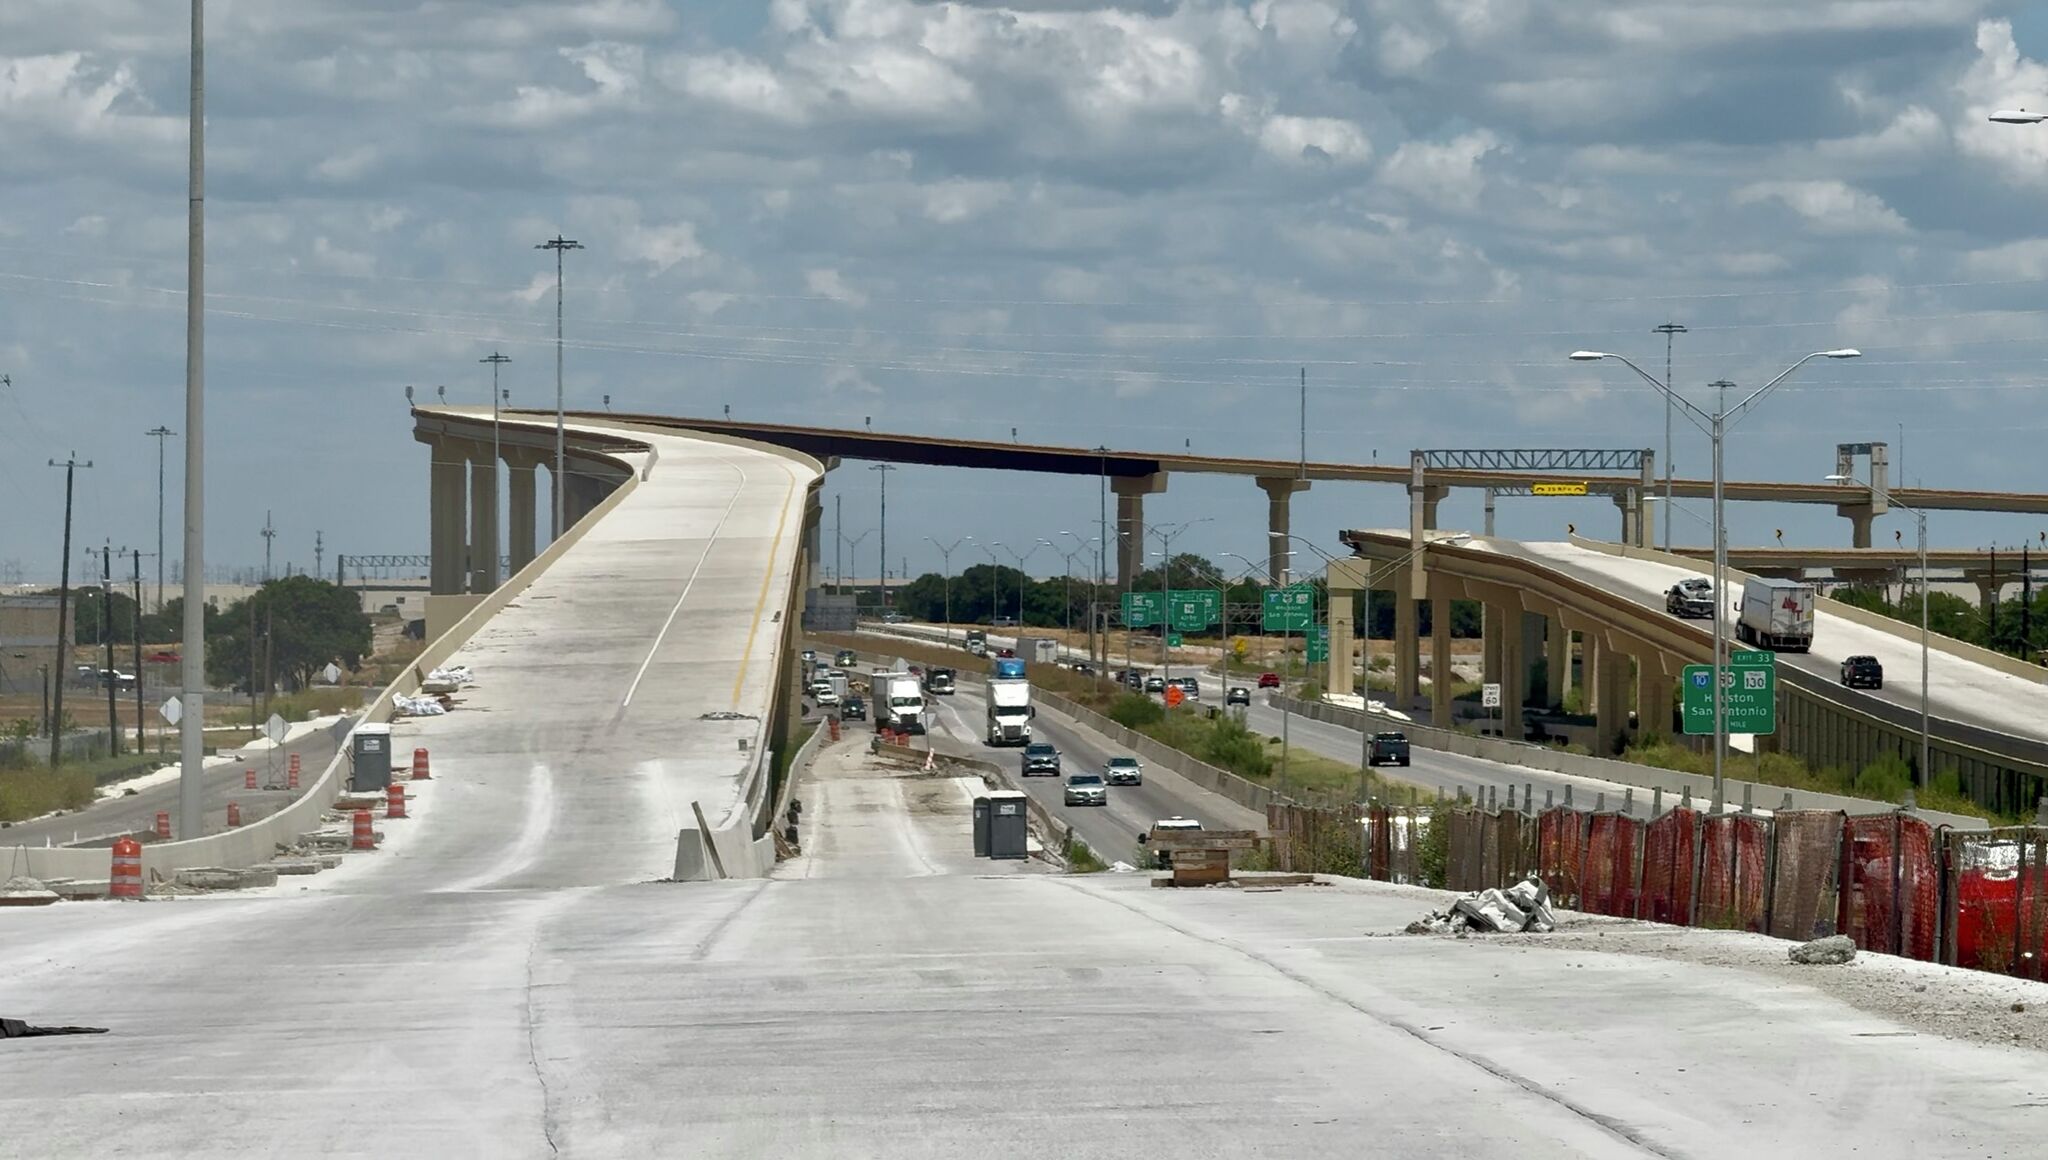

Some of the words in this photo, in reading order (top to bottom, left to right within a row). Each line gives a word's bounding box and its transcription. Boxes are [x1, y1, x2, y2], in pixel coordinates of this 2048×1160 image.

[1757, 654, 1770, 662] 33
[1696, 676, 1707, 686] 10
[1746, 677, 1765, 688] 130
[1485, 696, 1498, 704] 60
[1691, 706, 1713, 716] San
